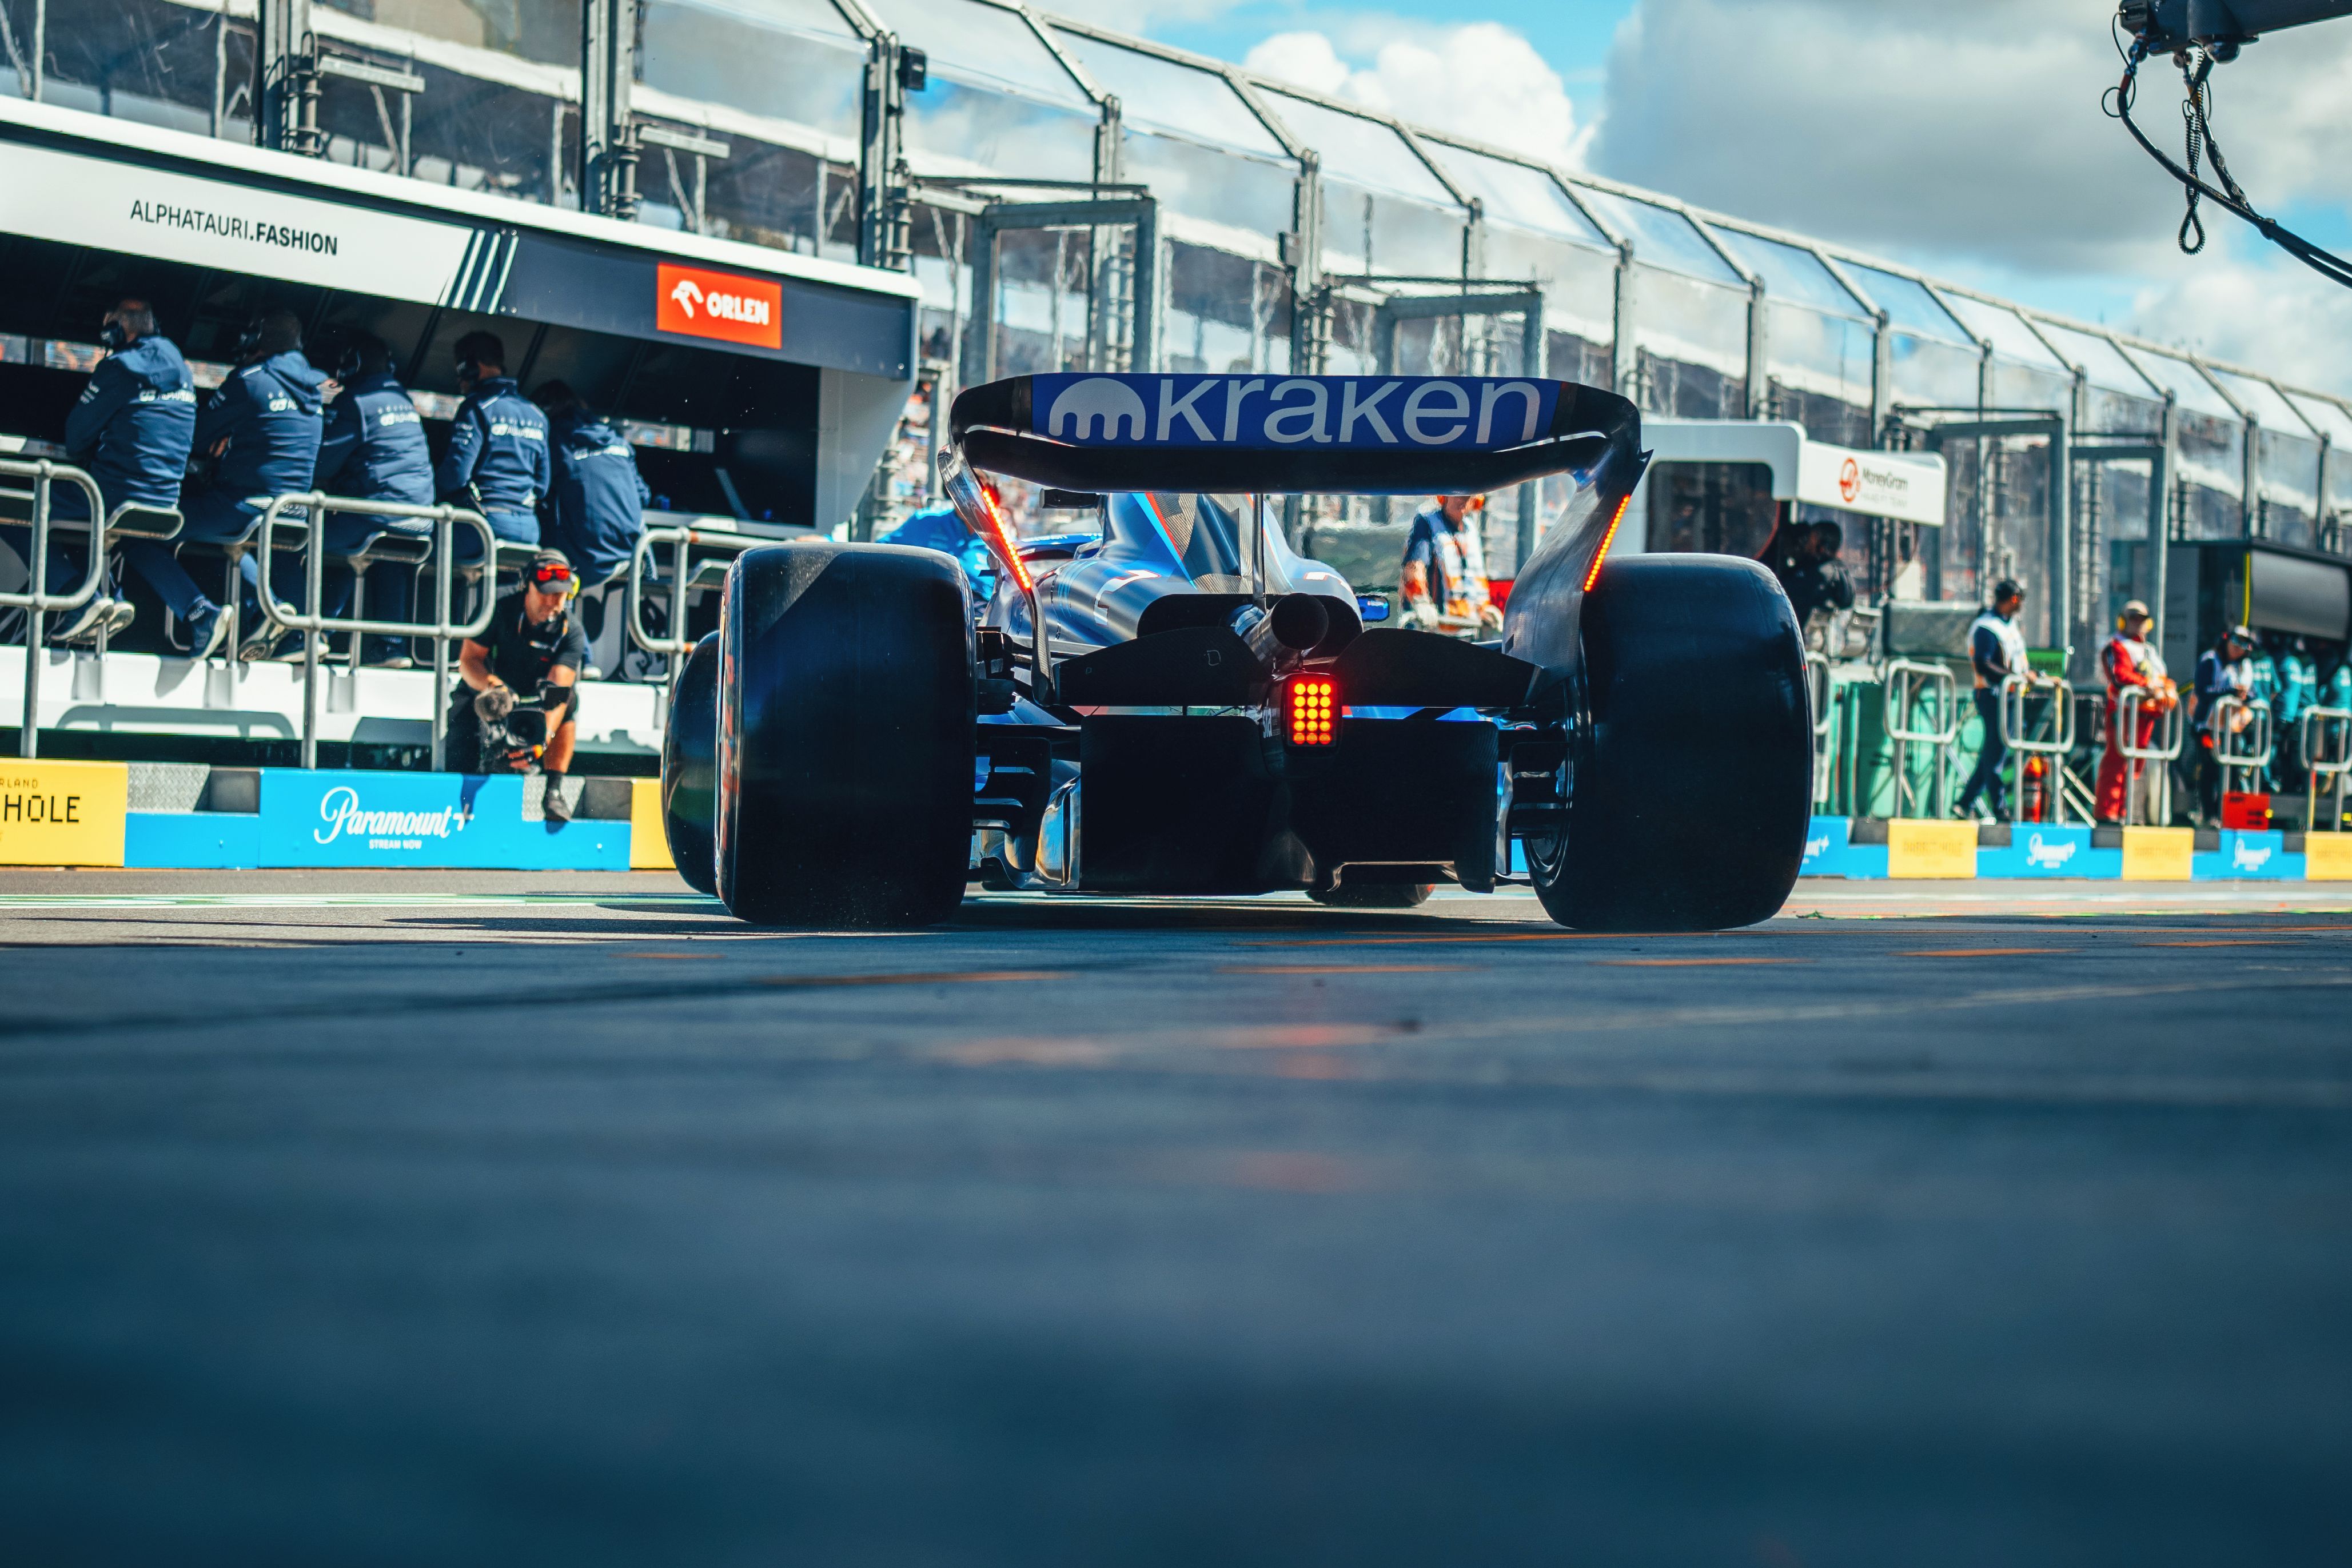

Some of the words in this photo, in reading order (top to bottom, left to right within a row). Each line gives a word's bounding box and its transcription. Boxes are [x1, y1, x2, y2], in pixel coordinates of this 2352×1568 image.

[130, 200, 338, 256] ALPHATAURI.FASHION
[707, 292, 769, 326] ORLEN
[1155, 378, 1541, 445] kraken
[1863, 467, 1908, 492] MoneyGram
[4, 794, 81, 823] HOLE
[369, 839, 401, 849] STREAM
[402, 839, 422, 850] NOW
